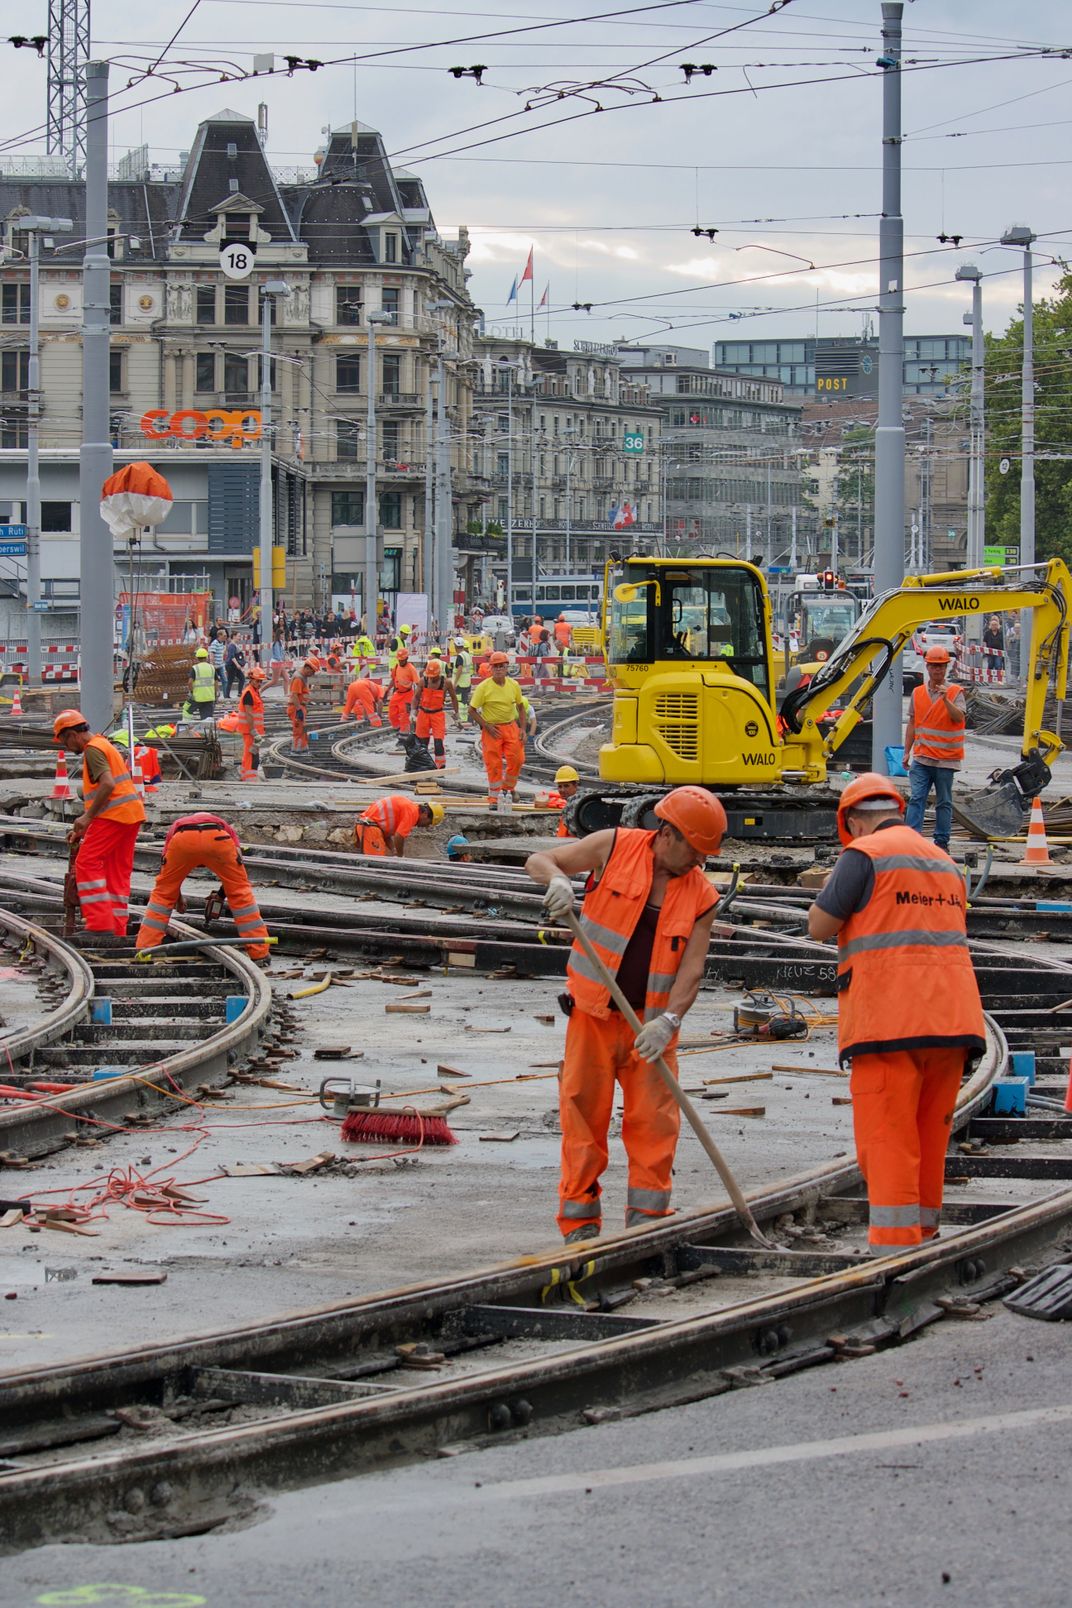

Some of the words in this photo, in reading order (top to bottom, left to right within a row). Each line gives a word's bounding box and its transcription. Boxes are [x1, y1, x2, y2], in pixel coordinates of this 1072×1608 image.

[227, 253, 247, 270] 18
[817, 377, 847, 390] POST
[140, 409, 262, 448] coop
[625, 436, 643, 449] 36
[938, 597, 980, 610] WALO
[626, 664, 649, 672] 75760
[741, 753, 776, 765] WALO
